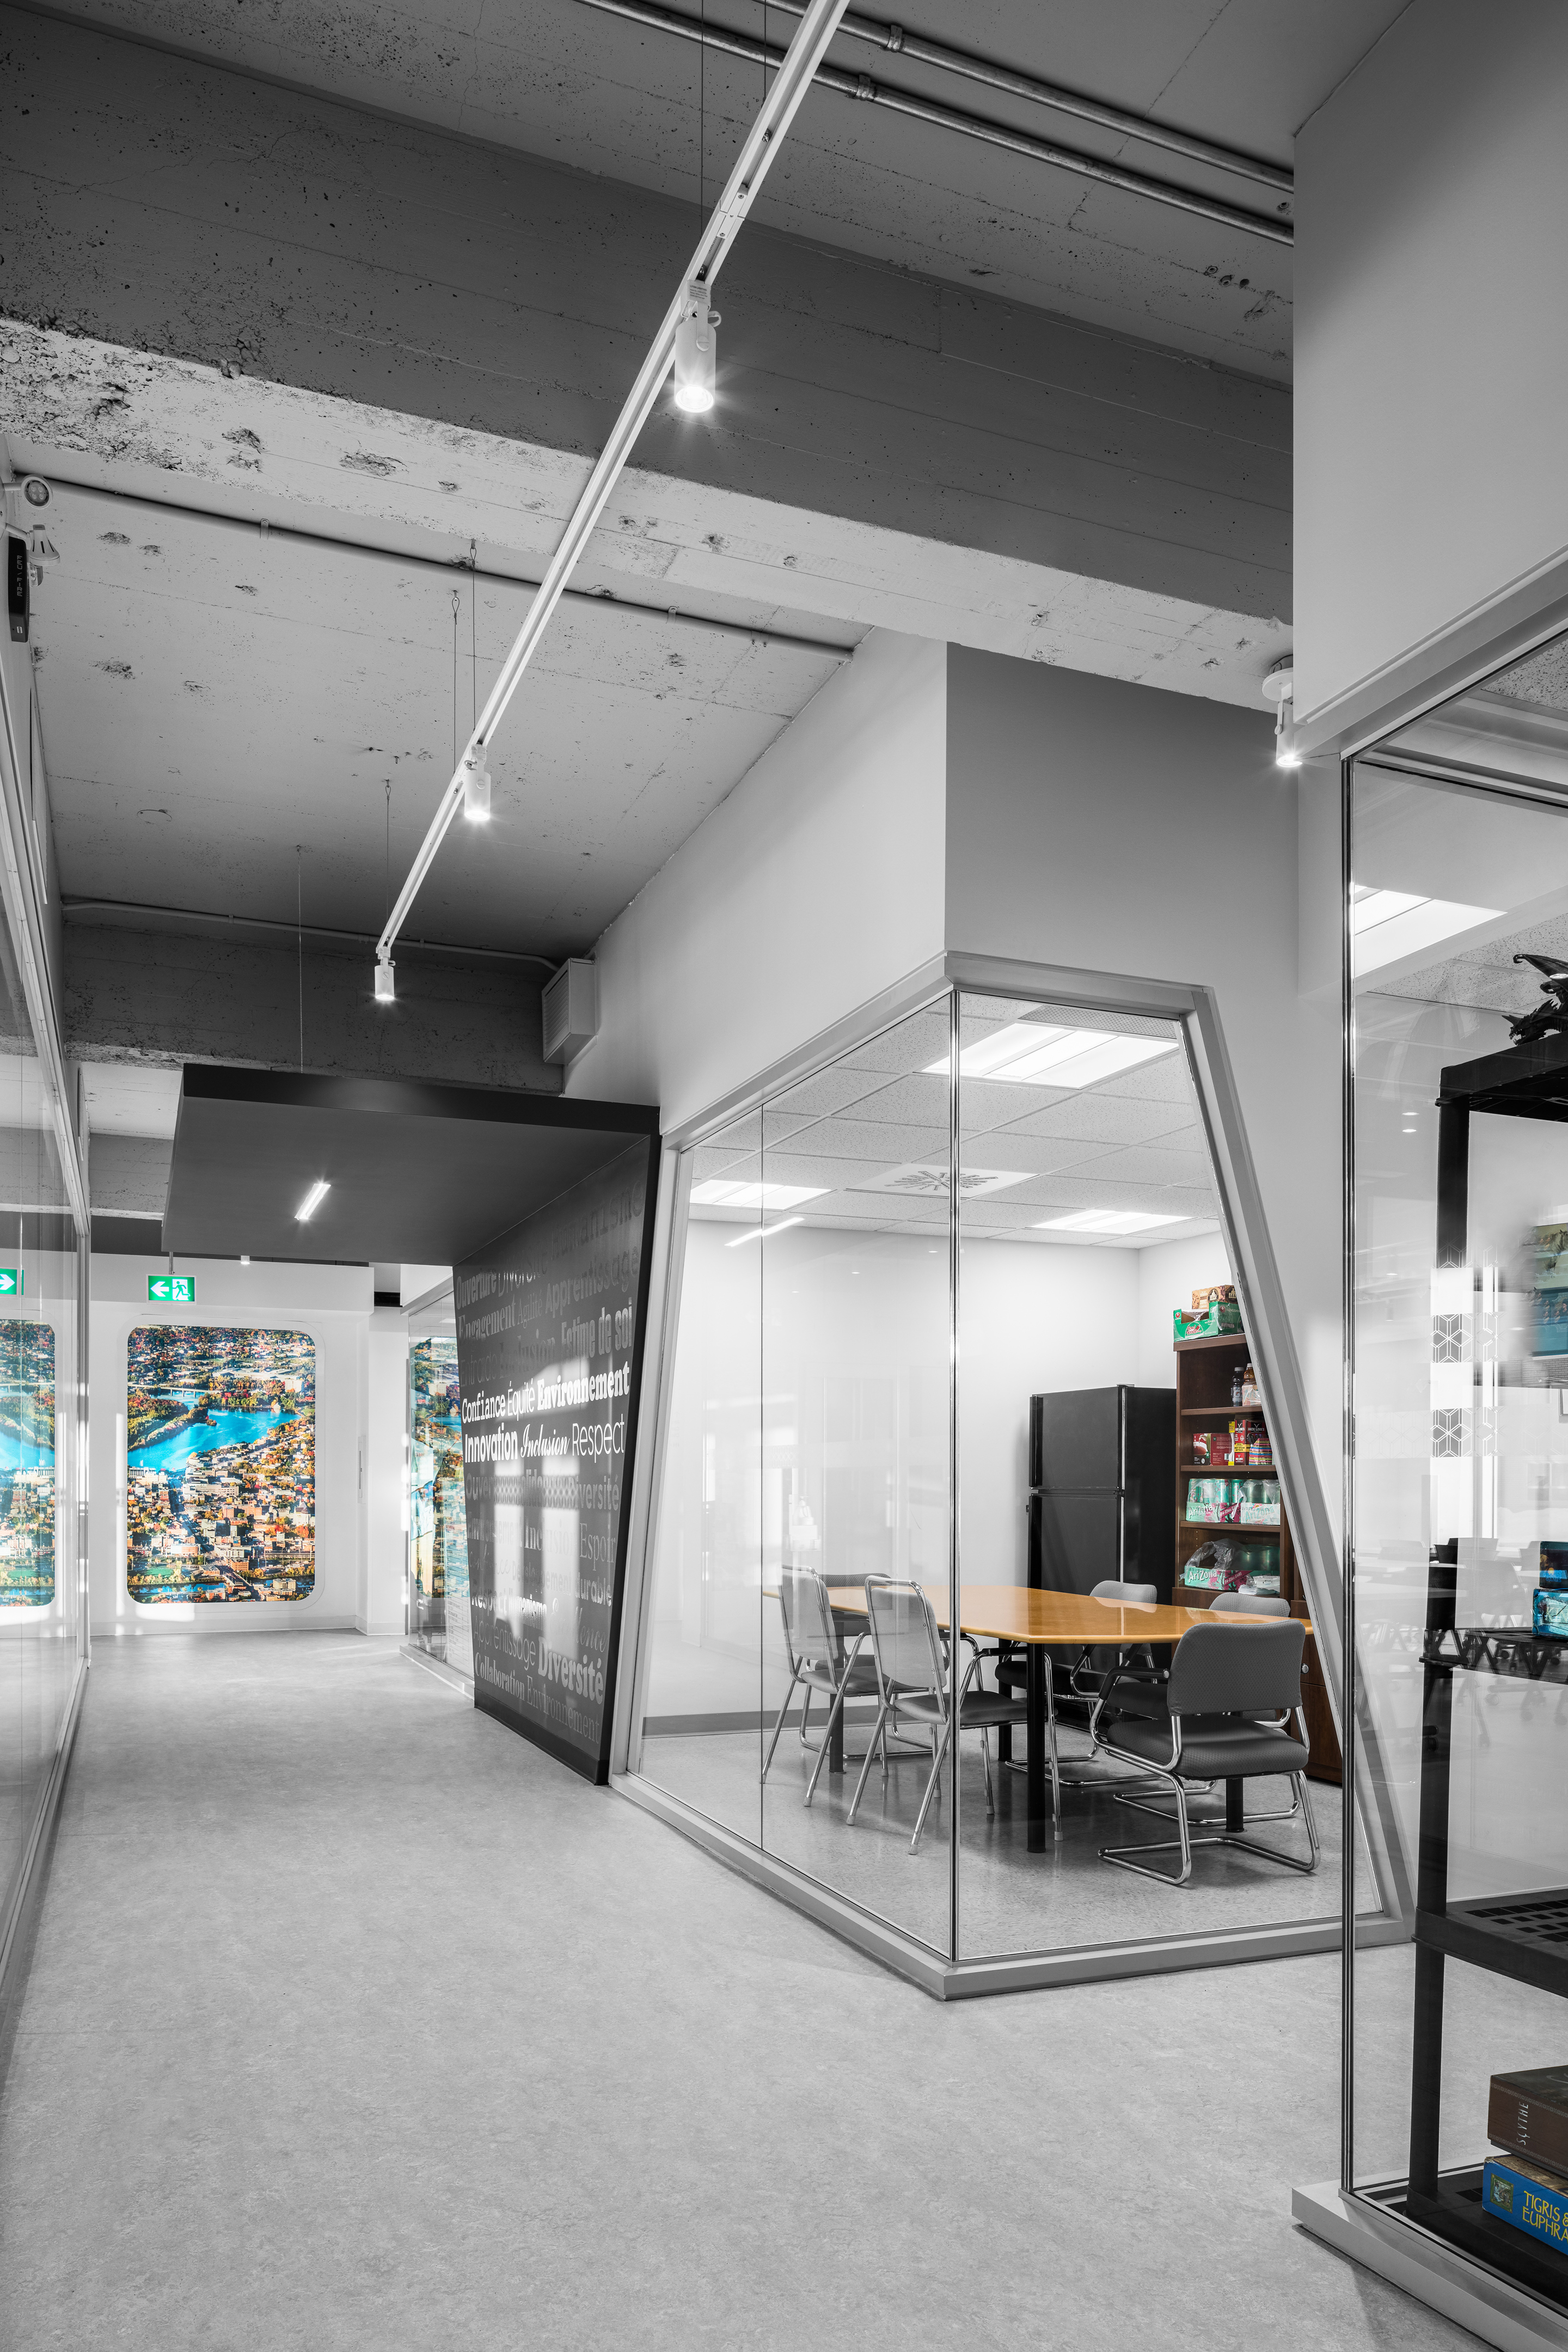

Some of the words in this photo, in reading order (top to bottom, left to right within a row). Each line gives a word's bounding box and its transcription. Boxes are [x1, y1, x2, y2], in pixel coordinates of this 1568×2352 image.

[456, 1267, 497, 1310] Ouverture
[551, 1180, 643, 1261] Humanisme
[458, 1294, 516, 1346] Engagement
[518, 1289, 542, 1329] Agilité
[545, 1246, 639, 1318] Apprentissage
[460, 1351, 497, 1387] Entraide
[499, 1328, 556, 1379] Inclusion
[561, 1316, 596, 1363] Estime
[599, 1307, 611, 1356] de
[615, 1296, 632, 1351] soi
[462, 1390, 506, 1424] Confiance
[507, 1377, 535, 1422] Équité
[537, 1361, 630, 1411] Environnement
[465, 1422, 518, 1463] Innovation
[520, 1424, 570, 1458] Inclusion
[572, 1413, 624, 1463] Respect
[567, 1473, 619, 1511] Diversité
[1189, 1505, 1213, 1520] AriZona
[1245, 1506, 1275, 1523] AriZona
[524, 1516, 578, 1557] Inclusion
[579, 1523, 616, 1571] Espoir
[471, 1579, 507, 1616] Respect
[574, 1572, 612, 1607] durable
[1189, 1570, 1217, 1584] AriZona
[474, 1615, 536, 1670] Apprentissage
[538, 1636, 603, 1704] Diversité
[475, 1652, 525, 1701] Collaboration
[526, 1675, 599, 1744] Environnement
[1516, 2101, 1530, 2146] SCYTHE
[1523, 2190, 1560, 2222] TIGRIS
